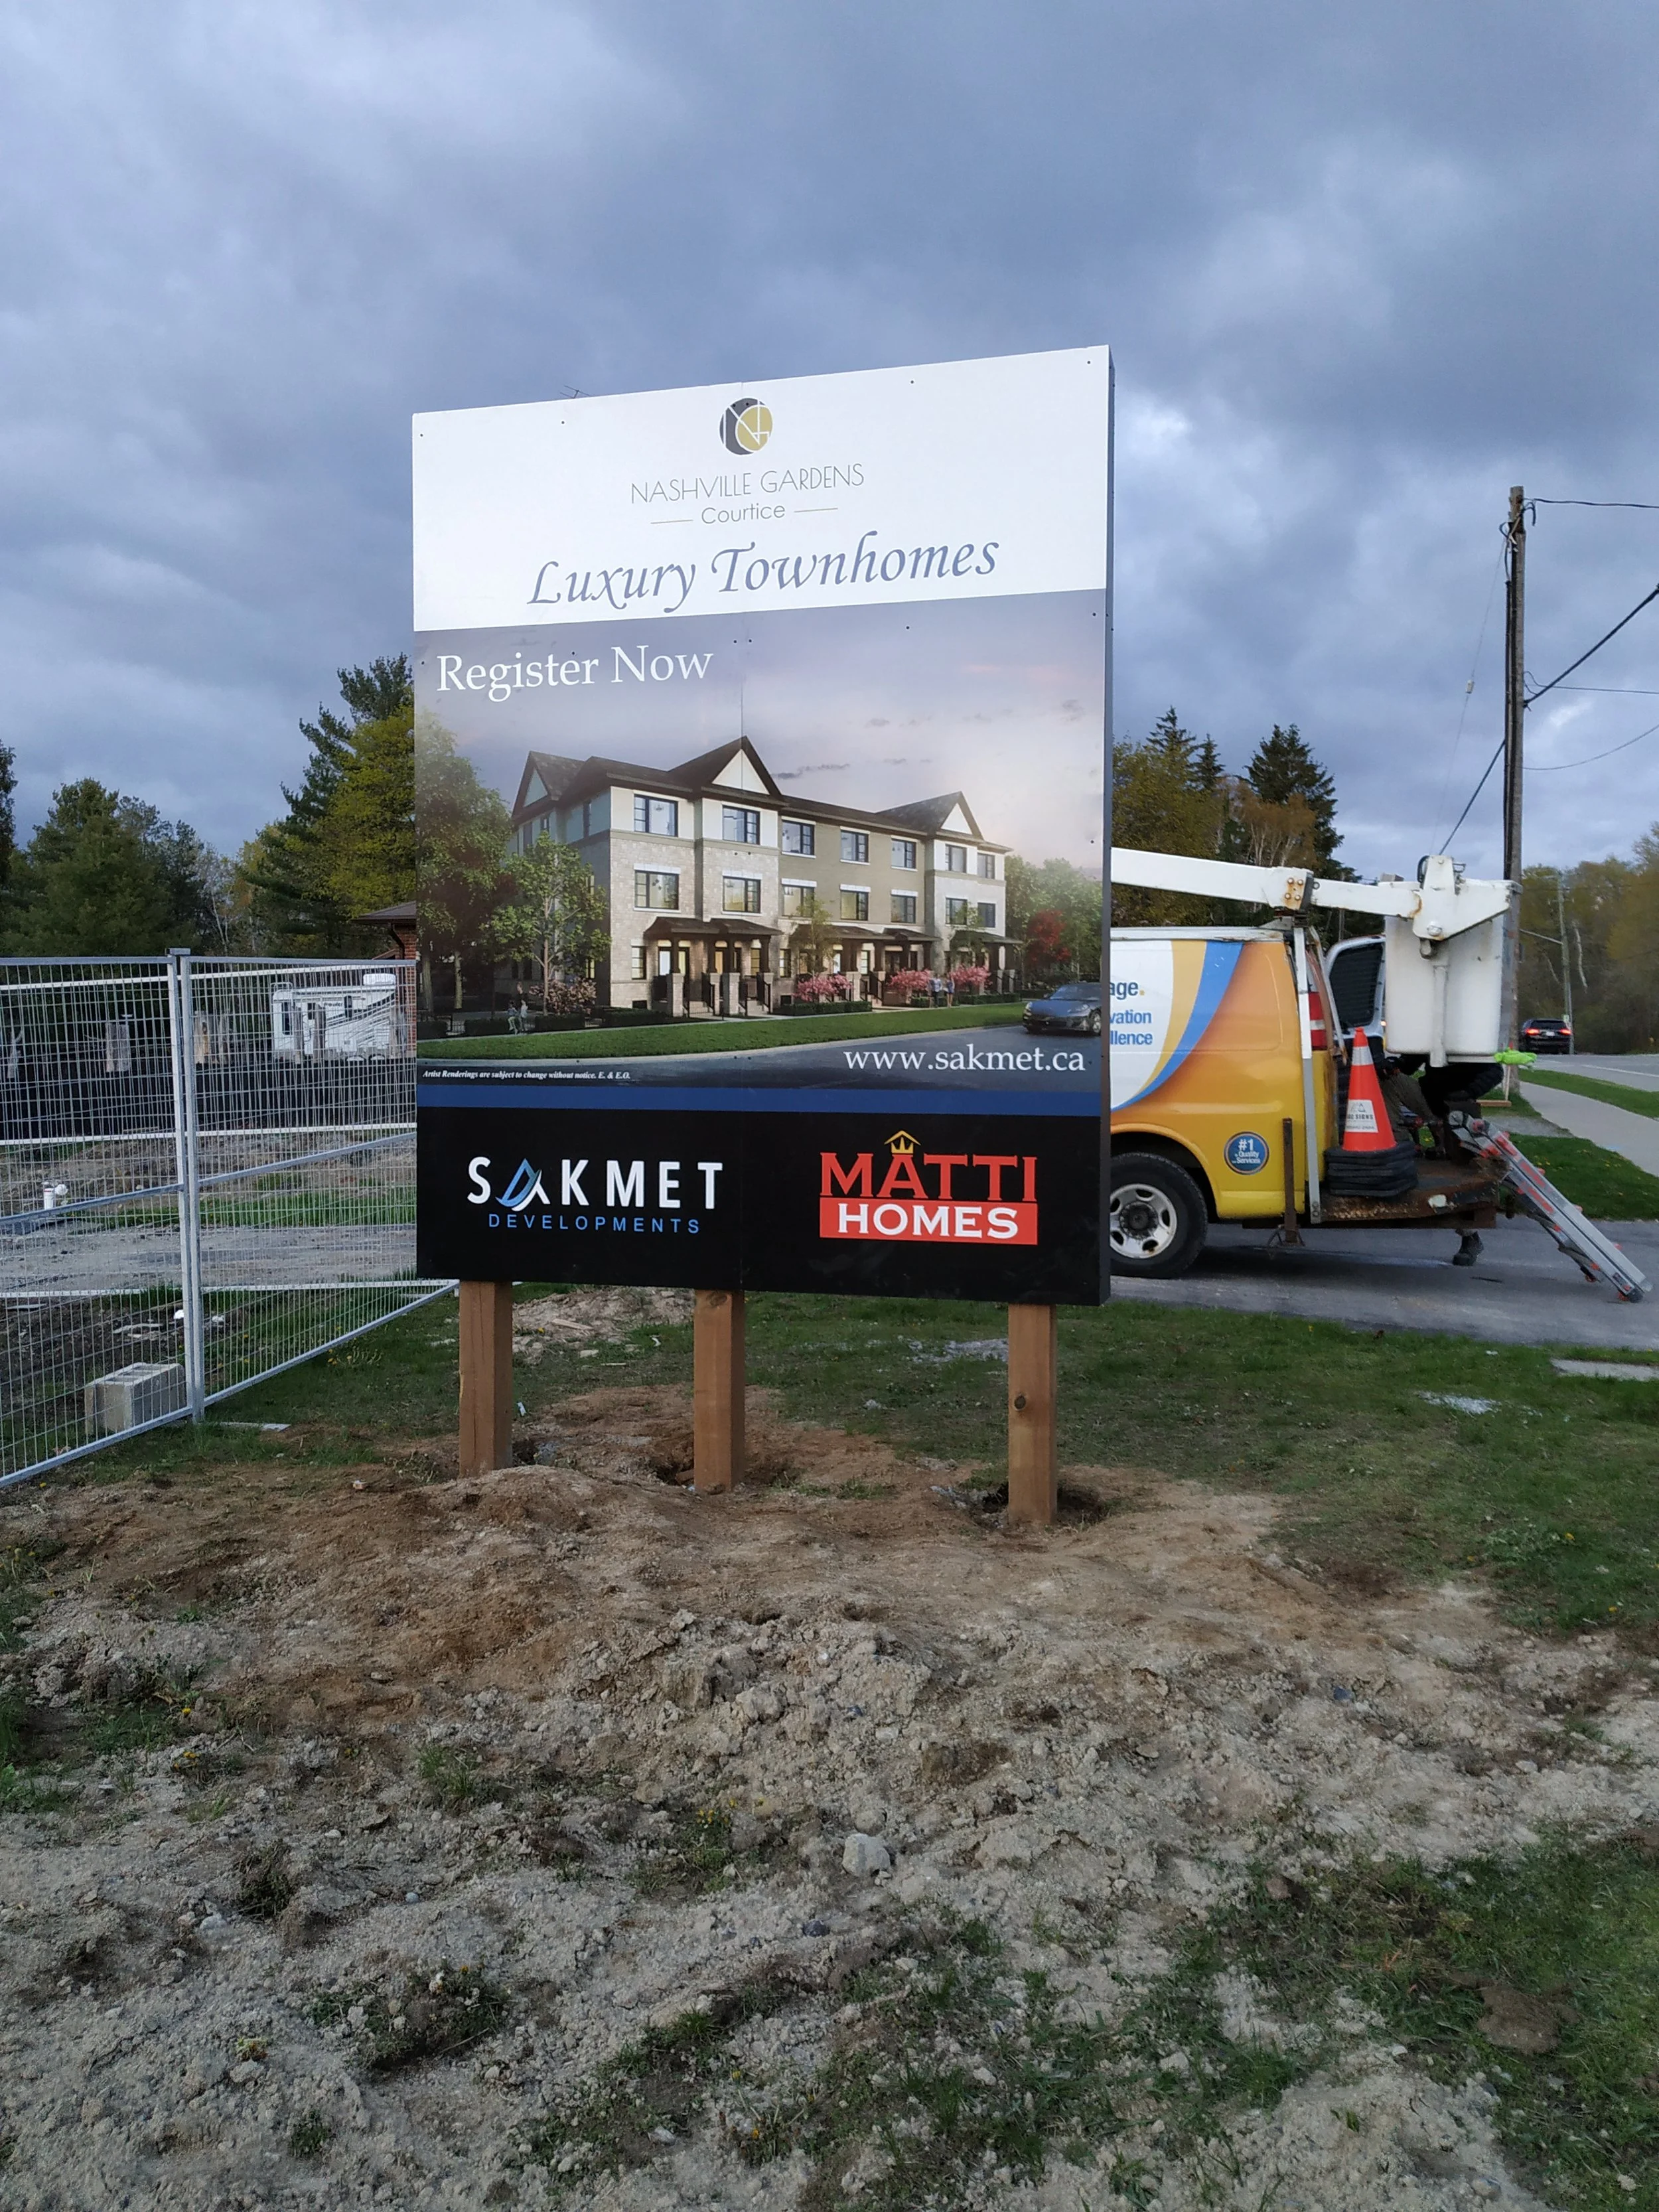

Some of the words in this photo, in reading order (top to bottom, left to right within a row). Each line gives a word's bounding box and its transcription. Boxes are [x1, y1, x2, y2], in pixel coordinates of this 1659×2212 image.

[631, 473, 751, 504] NASHVILLE
[760, 463, 865, 494] GARDENS
[701, 503, 785, 524] Courtice
[527, 561, 696, 613] Luxury
[711, 530, 999, 593] Townhomes
[437, 652, 599, 702] Register
[611, 644, 714, 683] Now
[422, 1070, 441, 1078] Artist
[442, 1070, 478, 1079] Renderings
[491, 1070, 514, 1080] subject
[523, 1070, 547, 1080] change
[548, 1070, 574, 1079] without
[574, 1070, 597, 1079] notice.
[843, 1043, 1086, 1072] www.sakmet.ca
[1238, 1138, 1254, 1151] #1
[467, 1156, 723, 1211] SAKMET
[820, 1151, 1038, 1202] MATTI
[488, 1213, 699, 1234] DEVELOPMENTS
[837, 1203, 1019, 1239] HOMES
